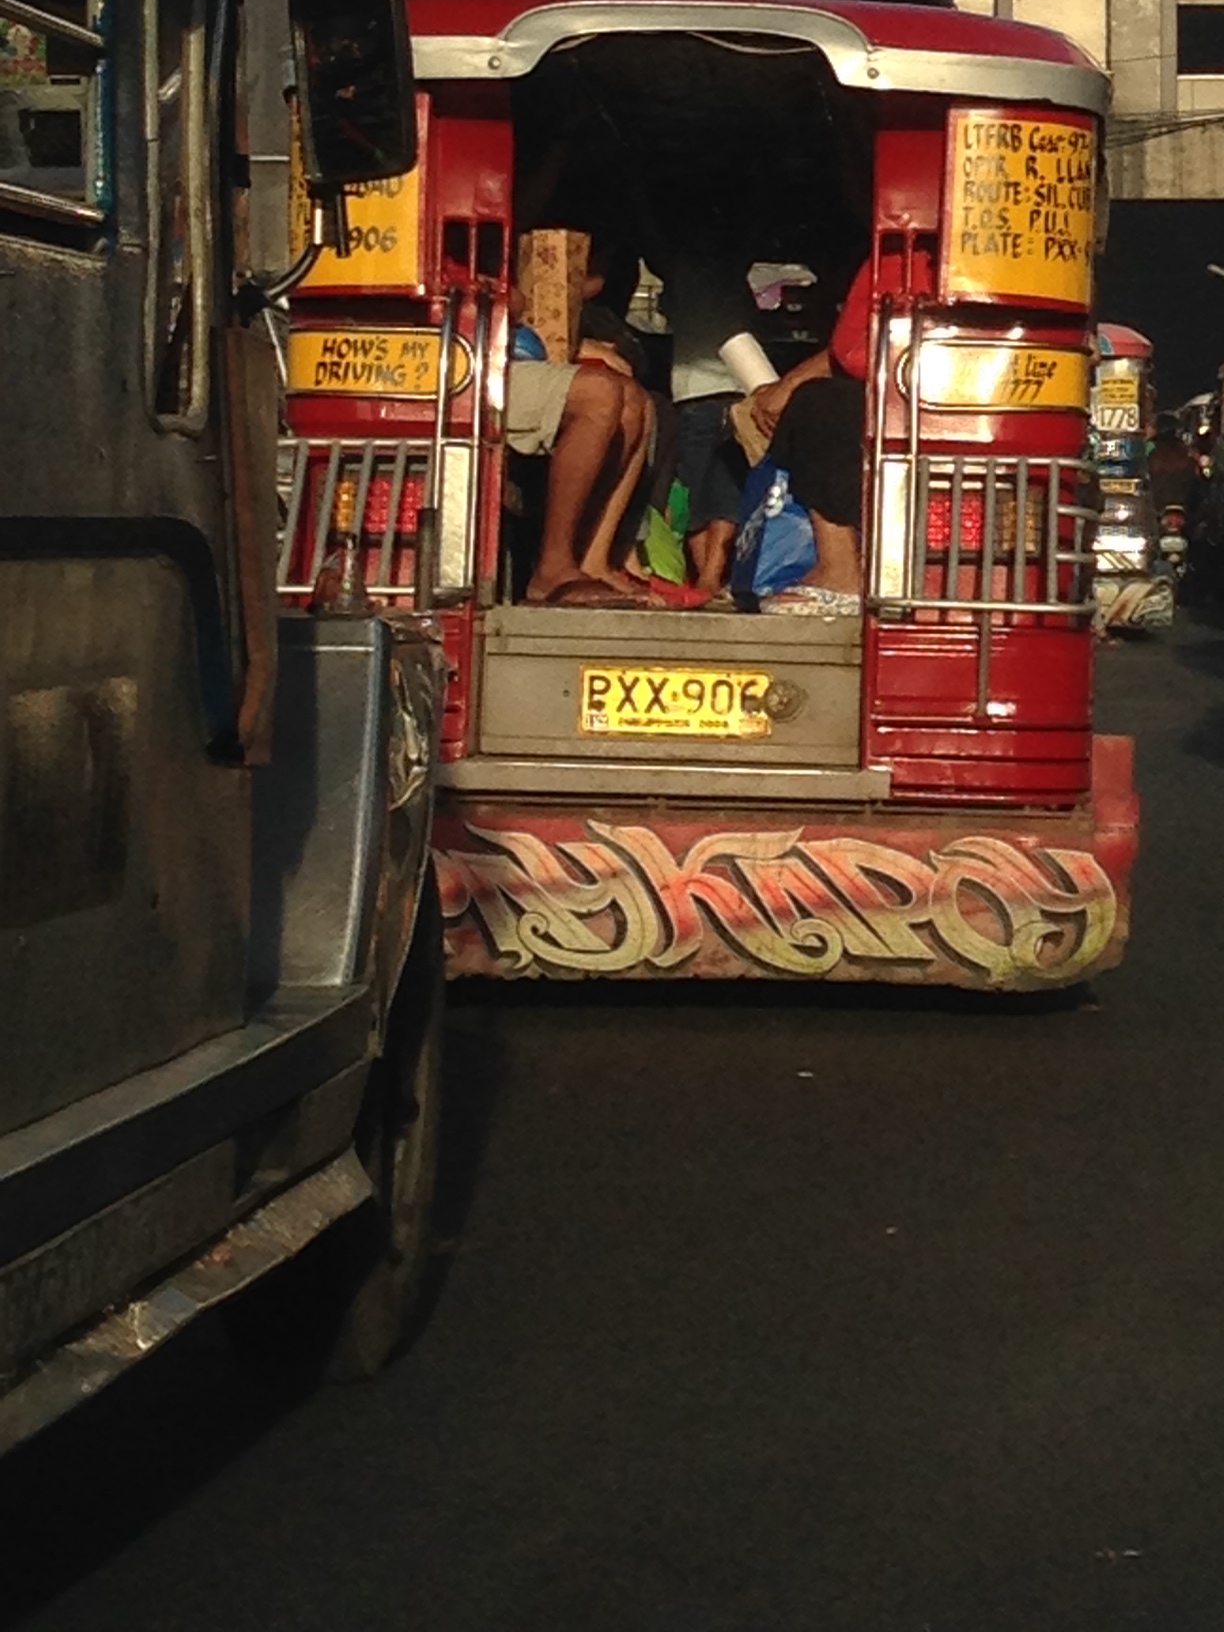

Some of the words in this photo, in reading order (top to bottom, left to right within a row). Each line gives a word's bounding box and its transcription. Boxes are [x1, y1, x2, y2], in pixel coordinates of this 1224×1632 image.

[963, 123, 1023, 153] LTFRB
[321, 335, 390, 361] HOW'S
[315, 361, 408, 388] DRIVING
